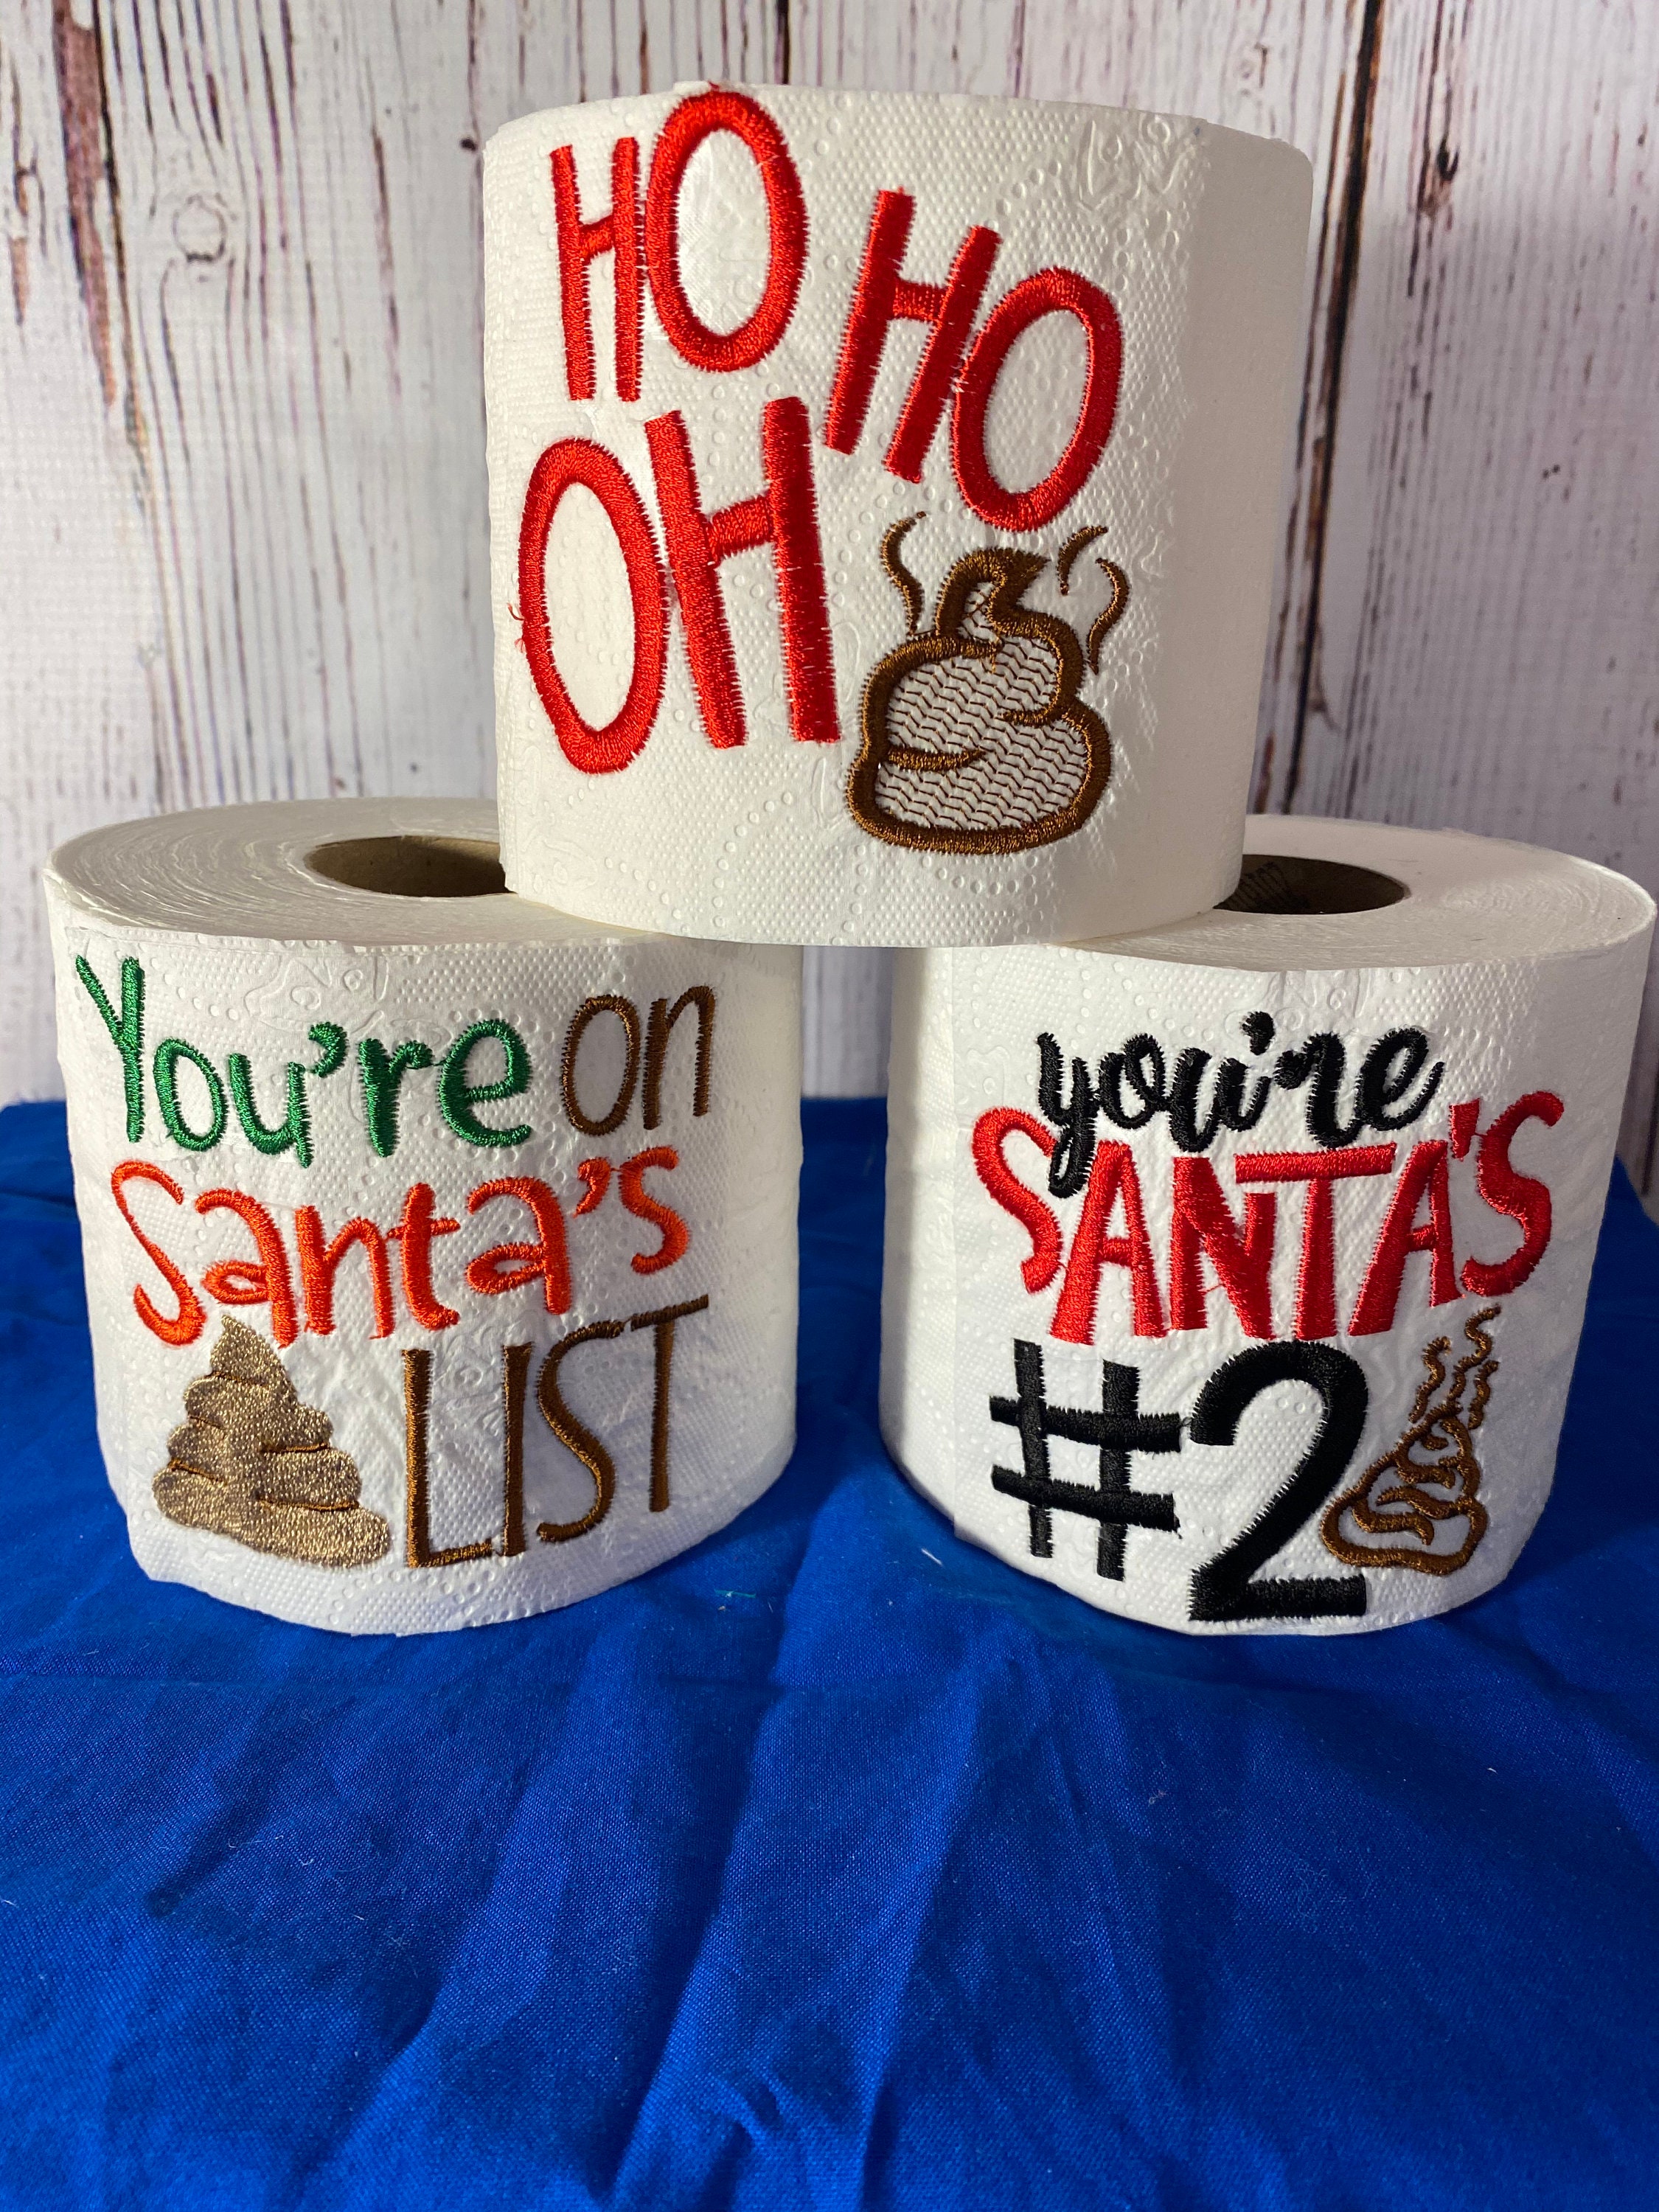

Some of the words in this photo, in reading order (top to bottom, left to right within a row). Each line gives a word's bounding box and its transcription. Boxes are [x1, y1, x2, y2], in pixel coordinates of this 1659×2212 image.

[551, 90, 808, 402] HO
[825, 187, 1123, 532] HO
[519, 396, 841, 775] OH
[75, 955, 532, 1168] You're
[560, 985, 716, 1135] on
[1036, 1010, 1446, 1199] you're
[111, 1146, 690, 1347] Santa's
[971, 1090, 1565, 1346] SANTA'S
[401, 1294, 709, 1568] LIST
[989, 1338, 1368, 1622] #2
